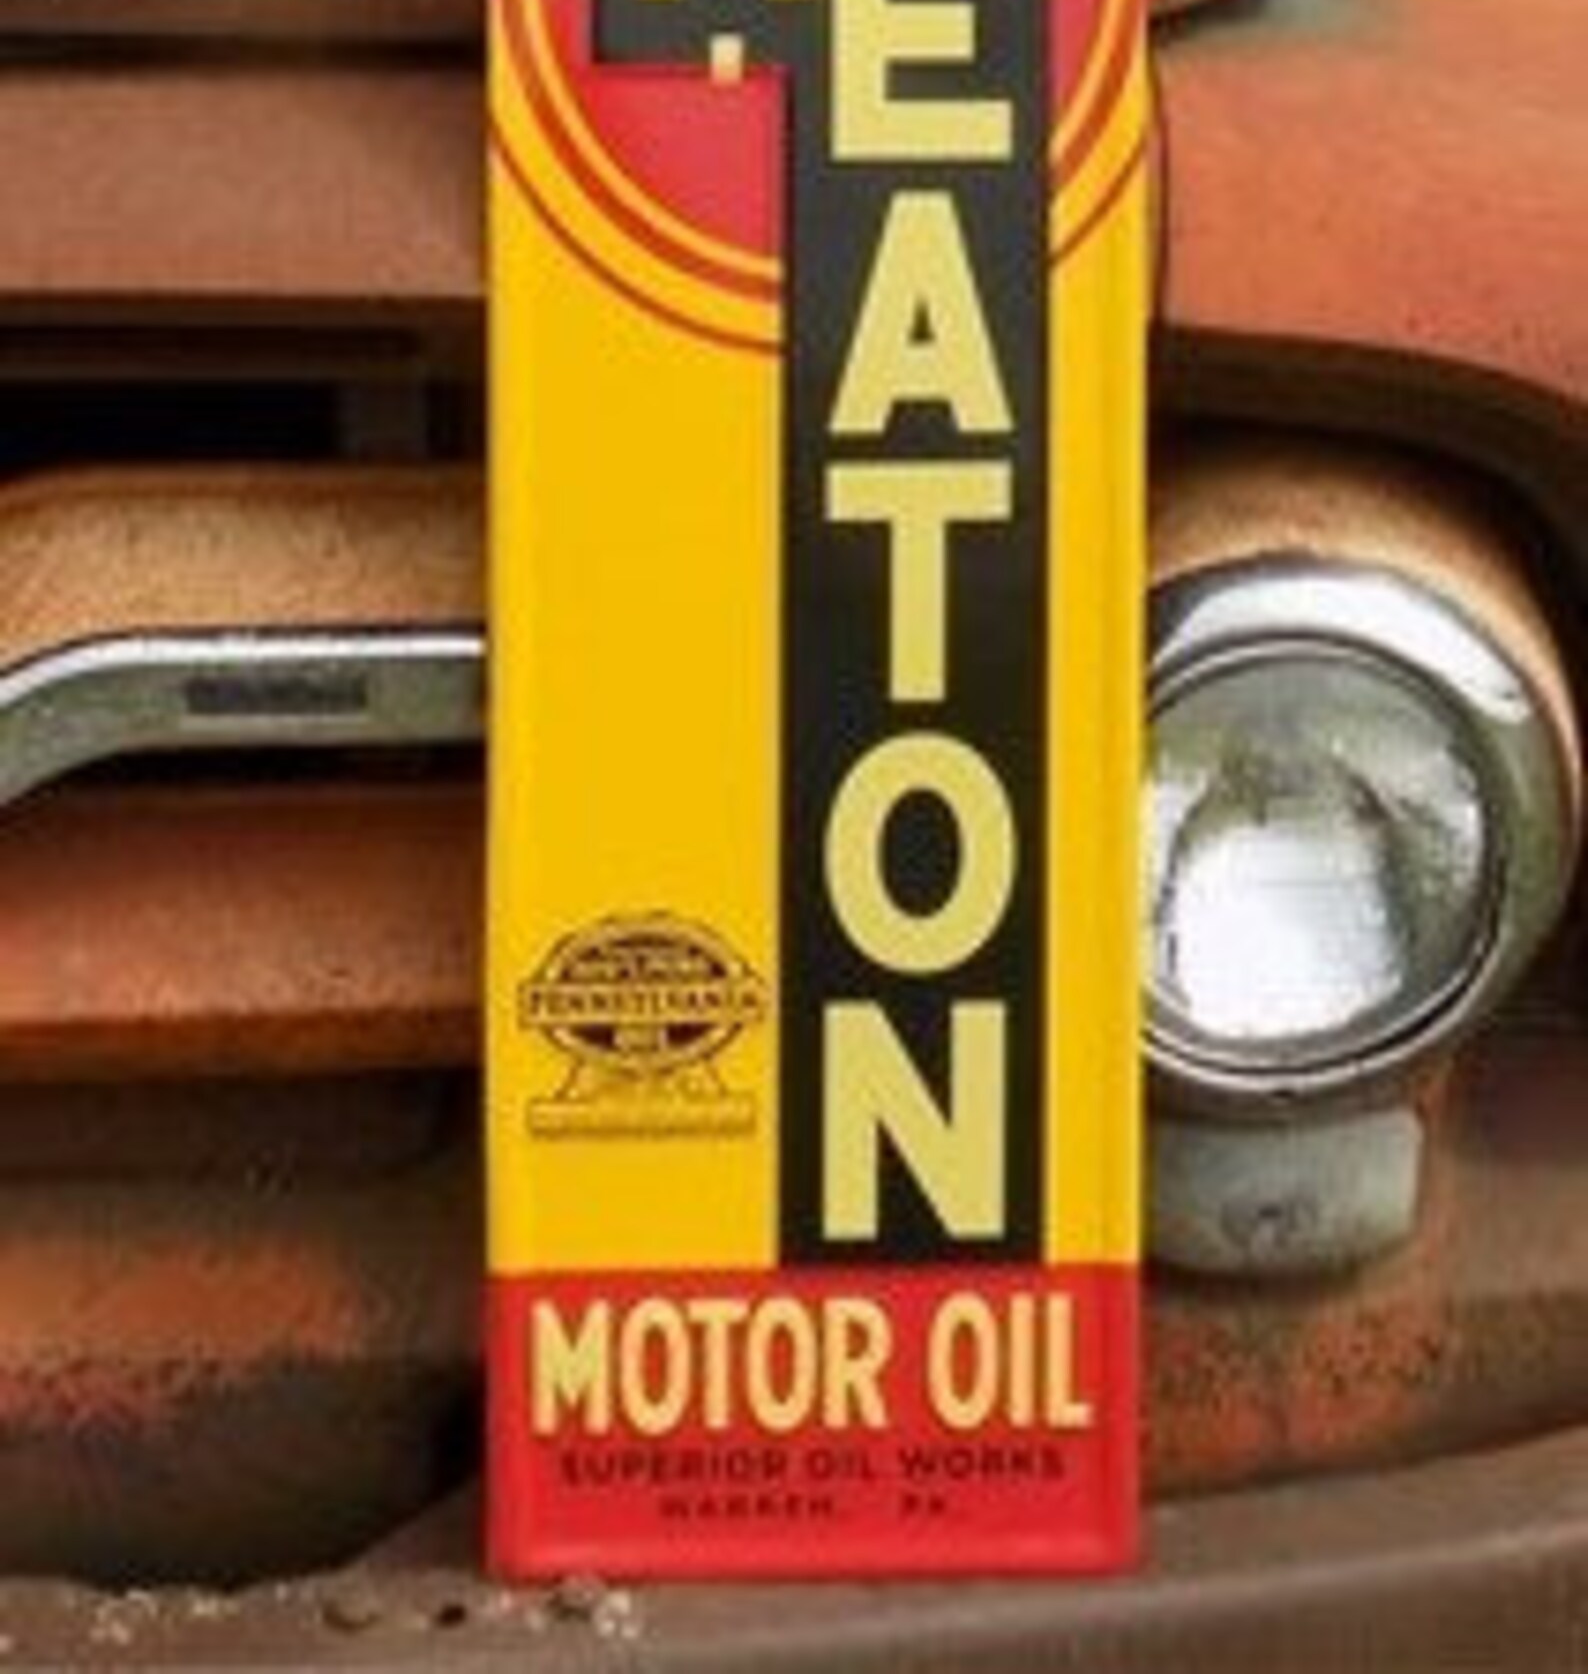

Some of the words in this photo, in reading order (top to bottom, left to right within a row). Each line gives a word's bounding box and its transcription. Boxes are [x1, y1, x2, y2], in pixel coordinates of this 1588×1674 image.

[531, 1296, 893, 1435] MOTOR
[926, 1290, 1094, 1431] OIL
[559, 1446, 789, 1487] SUPERIOR
[803, 1446, 873, 1482] OIL
[896, 1442, 1067, 1481] WORKS
